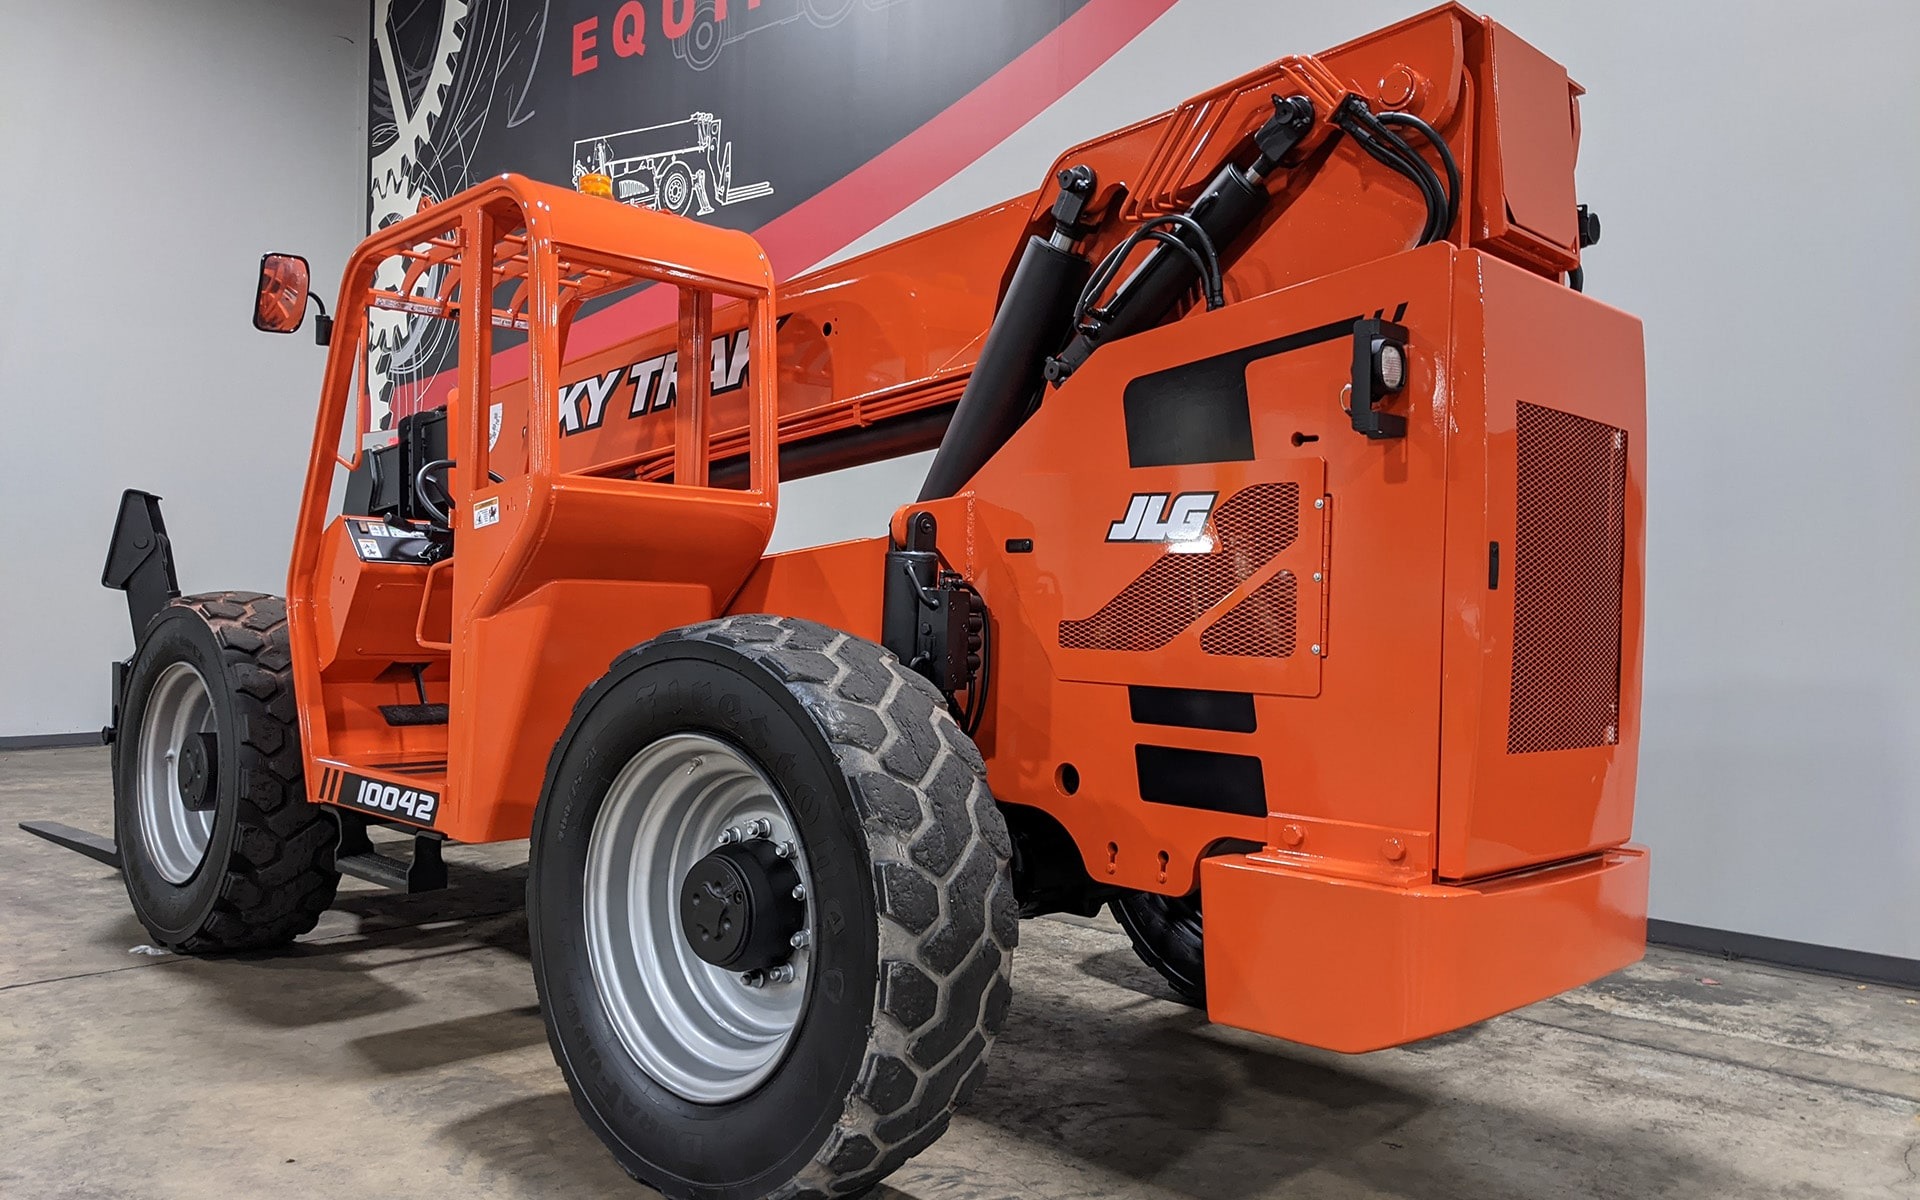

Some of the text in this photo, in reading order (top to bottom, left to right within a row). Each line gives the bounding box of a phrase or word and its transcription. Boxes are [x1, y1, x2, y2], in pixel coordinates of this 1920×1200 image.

[572, 0, 761, 76] EQU
[558, 367, 625, 435] KY
[1105, 492, 1218, 542] JLG
[357, 780, 435, 820] 10042
